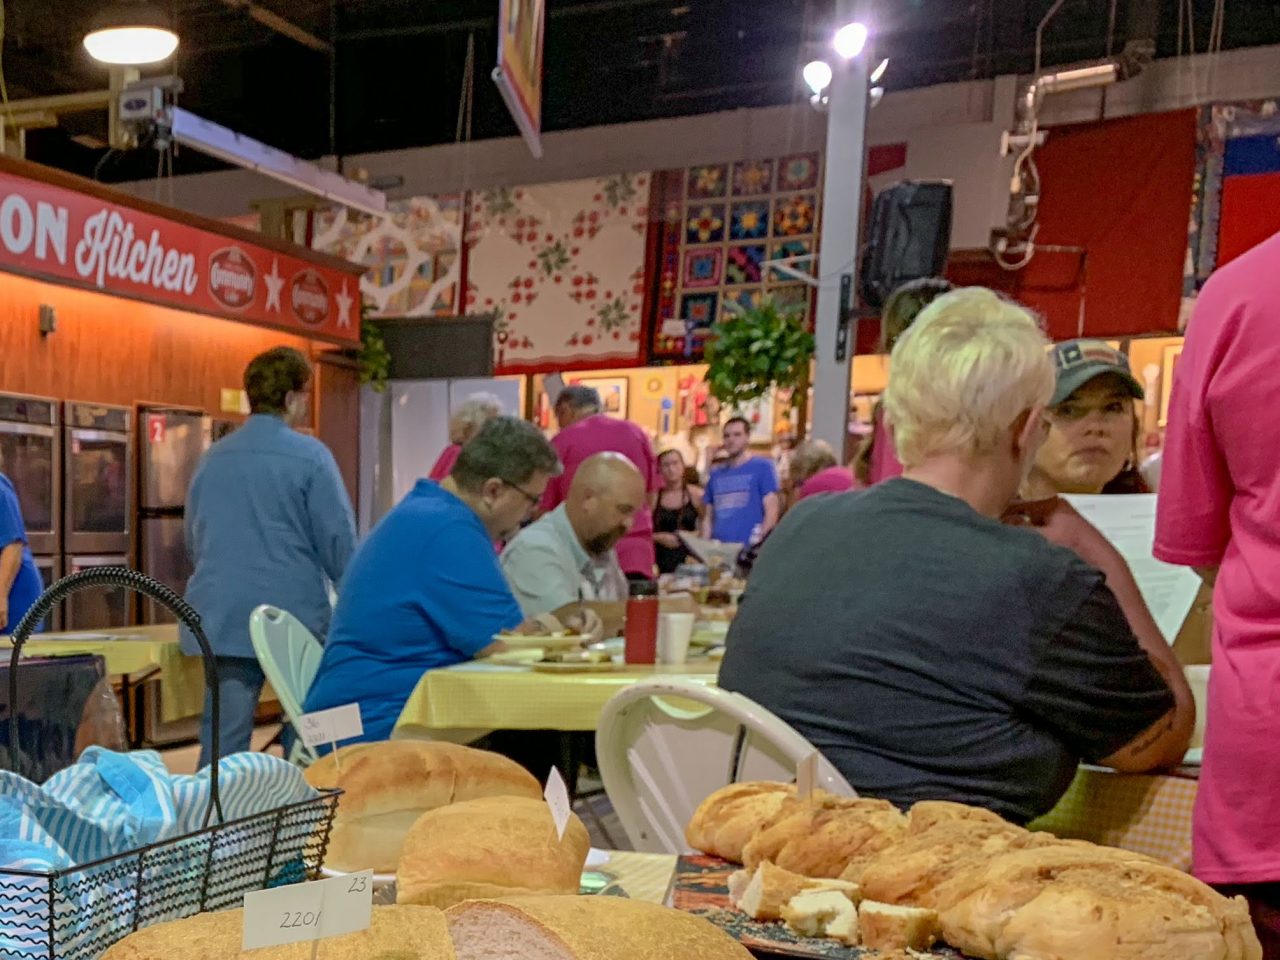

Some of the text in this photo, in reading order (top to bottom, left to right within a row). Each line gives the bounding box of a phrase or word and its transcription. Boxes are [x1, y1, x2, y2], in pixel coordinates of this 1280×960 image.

[75, 208, 198, 295] Kitchen
[347, 876, 367, 893] 23
[279, 911, 321, 928] 2201
